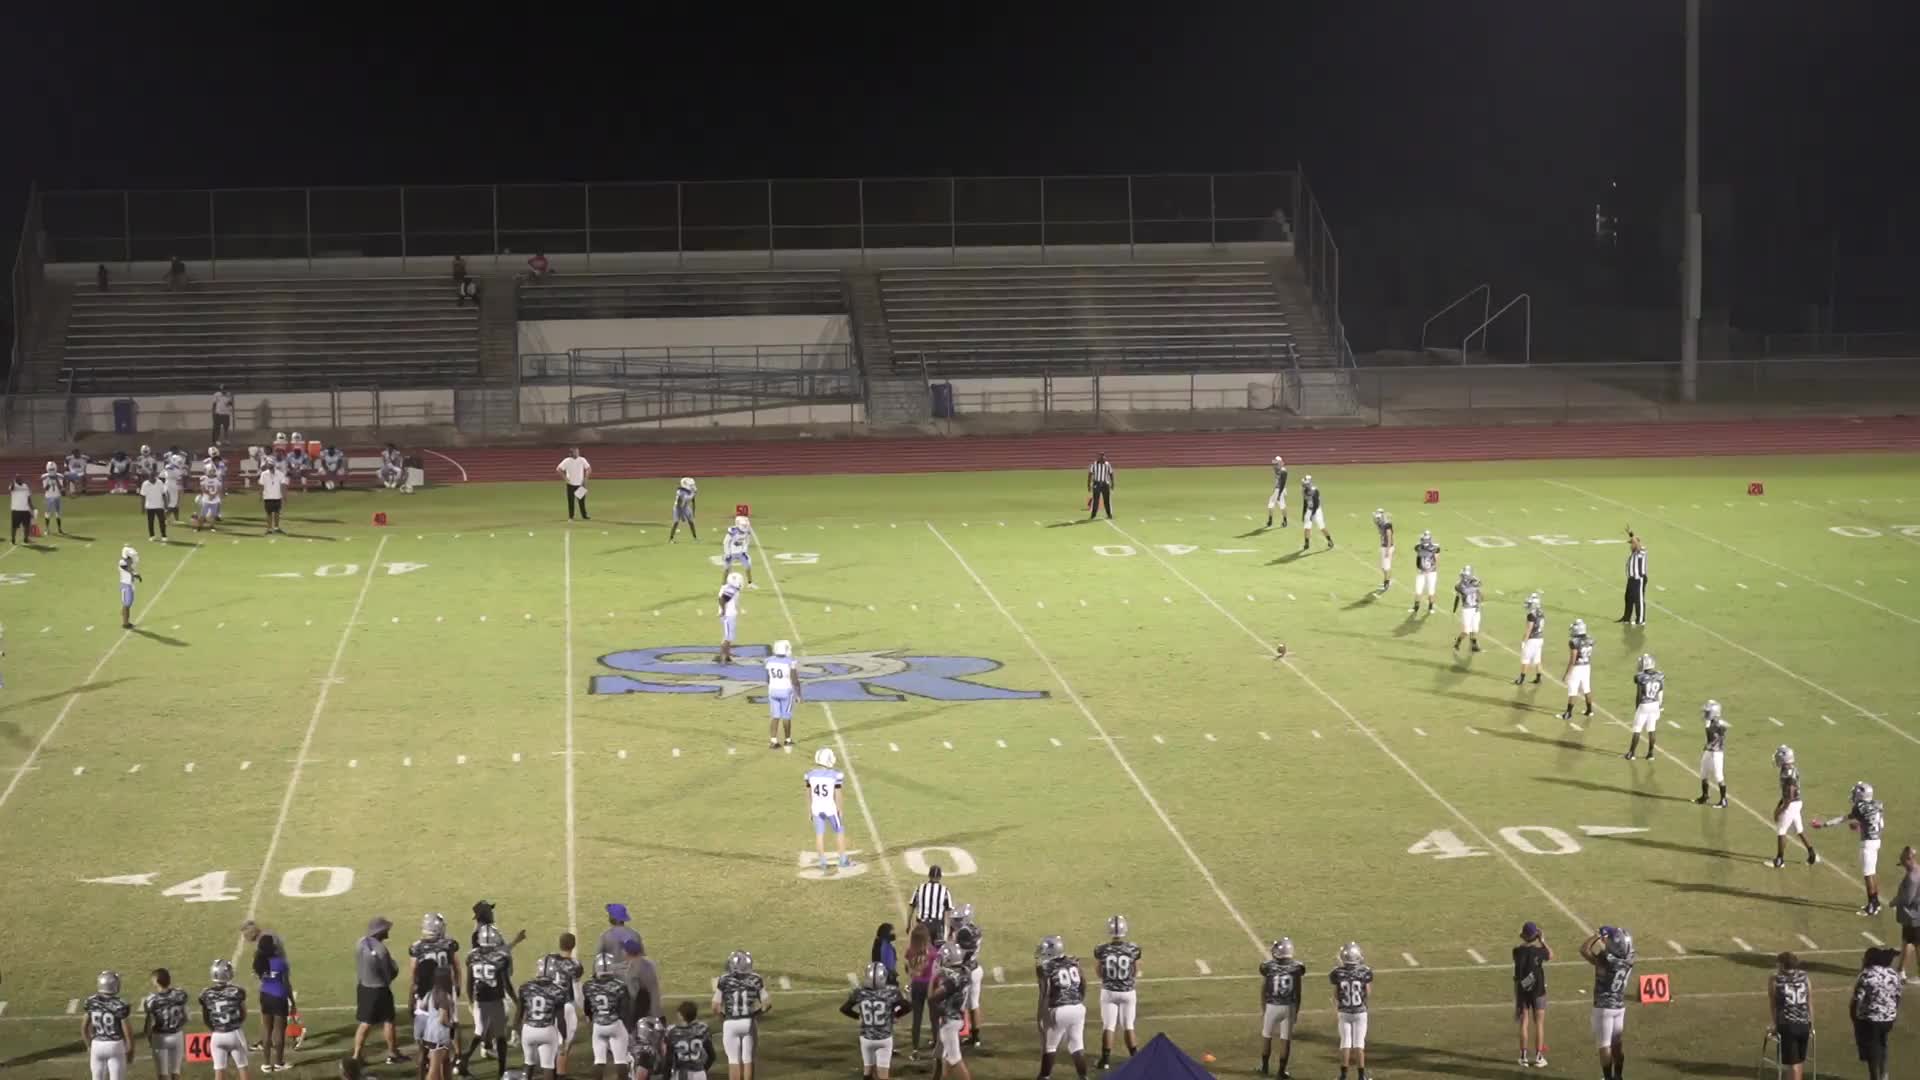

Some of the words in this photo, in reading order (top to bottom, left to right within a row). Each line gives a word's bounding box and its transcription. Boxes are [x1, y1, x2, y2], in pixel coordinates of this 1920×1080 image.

[771, 668, 784, 680] 50
[814, 784, 829, 797] 45
[1408, 826, 1582, 859] 40
[161, 866, 355, 903] 40
[1106, 955, 1130, 980] 68
[1340, 981, 1361, 1006] 38
[1643, 977, 1667, 999] 40
[1785, 982, 1807, 1004] 52
[215, 1000, 229, 1024] 5
[532, 996, 546, 1020] 8
[595, 995, 609, 1014] 2
[732, 990, 748, 1016] 11
[861, 1000, 886, 1025] 62
